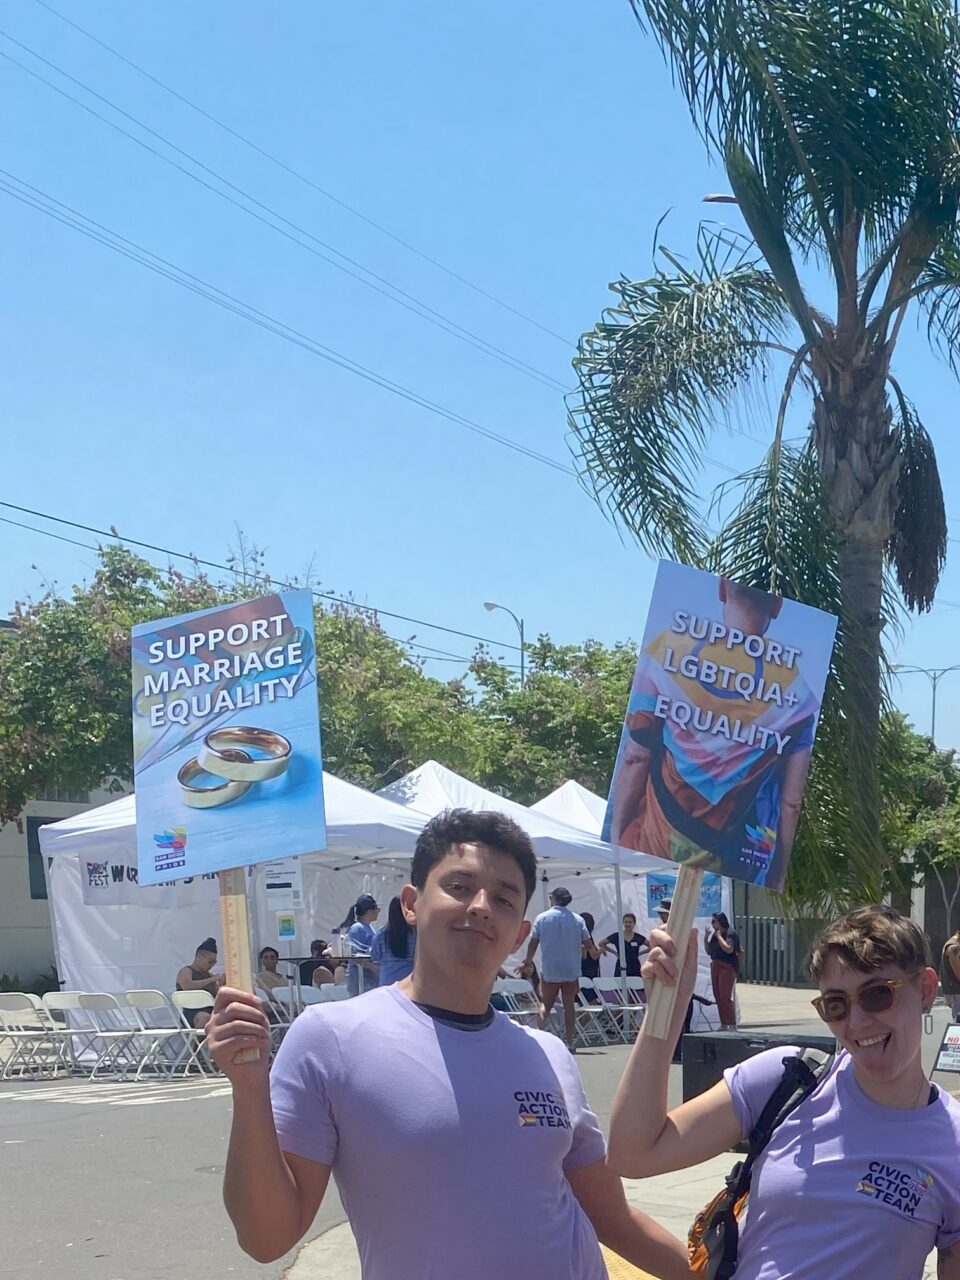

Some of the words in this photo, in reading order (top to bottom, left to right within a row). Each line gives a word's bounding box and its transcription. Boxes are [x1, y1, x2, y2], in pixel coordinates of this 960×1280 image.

[149, 614, 288, 664] SUPPORT
[671, 610, 801, 670] SUPPORT
[144, 643, 303, 696] MARRIAGE
[663, 647, 799, 708] LGBTQIA+
[151, 675, 300, 727] EQUALITY
[654, 695, 792, 756] EQUALITY
[89, 874, 109, 886] FEST
[156, 860, 185, 871] PRIDE
[947, 1036, 959, 1044] NO
[514, 1091, 555, 1104] CIVIC
[519, 1103, 569, 1119] ACTION
[536, 1115, 573, 1130] TEAM
[868, 1161, 911, 1185] CIVIC
[862, 1173, 921, 1207] ACTION
[875, 1188, 915, 1217] TEAM
